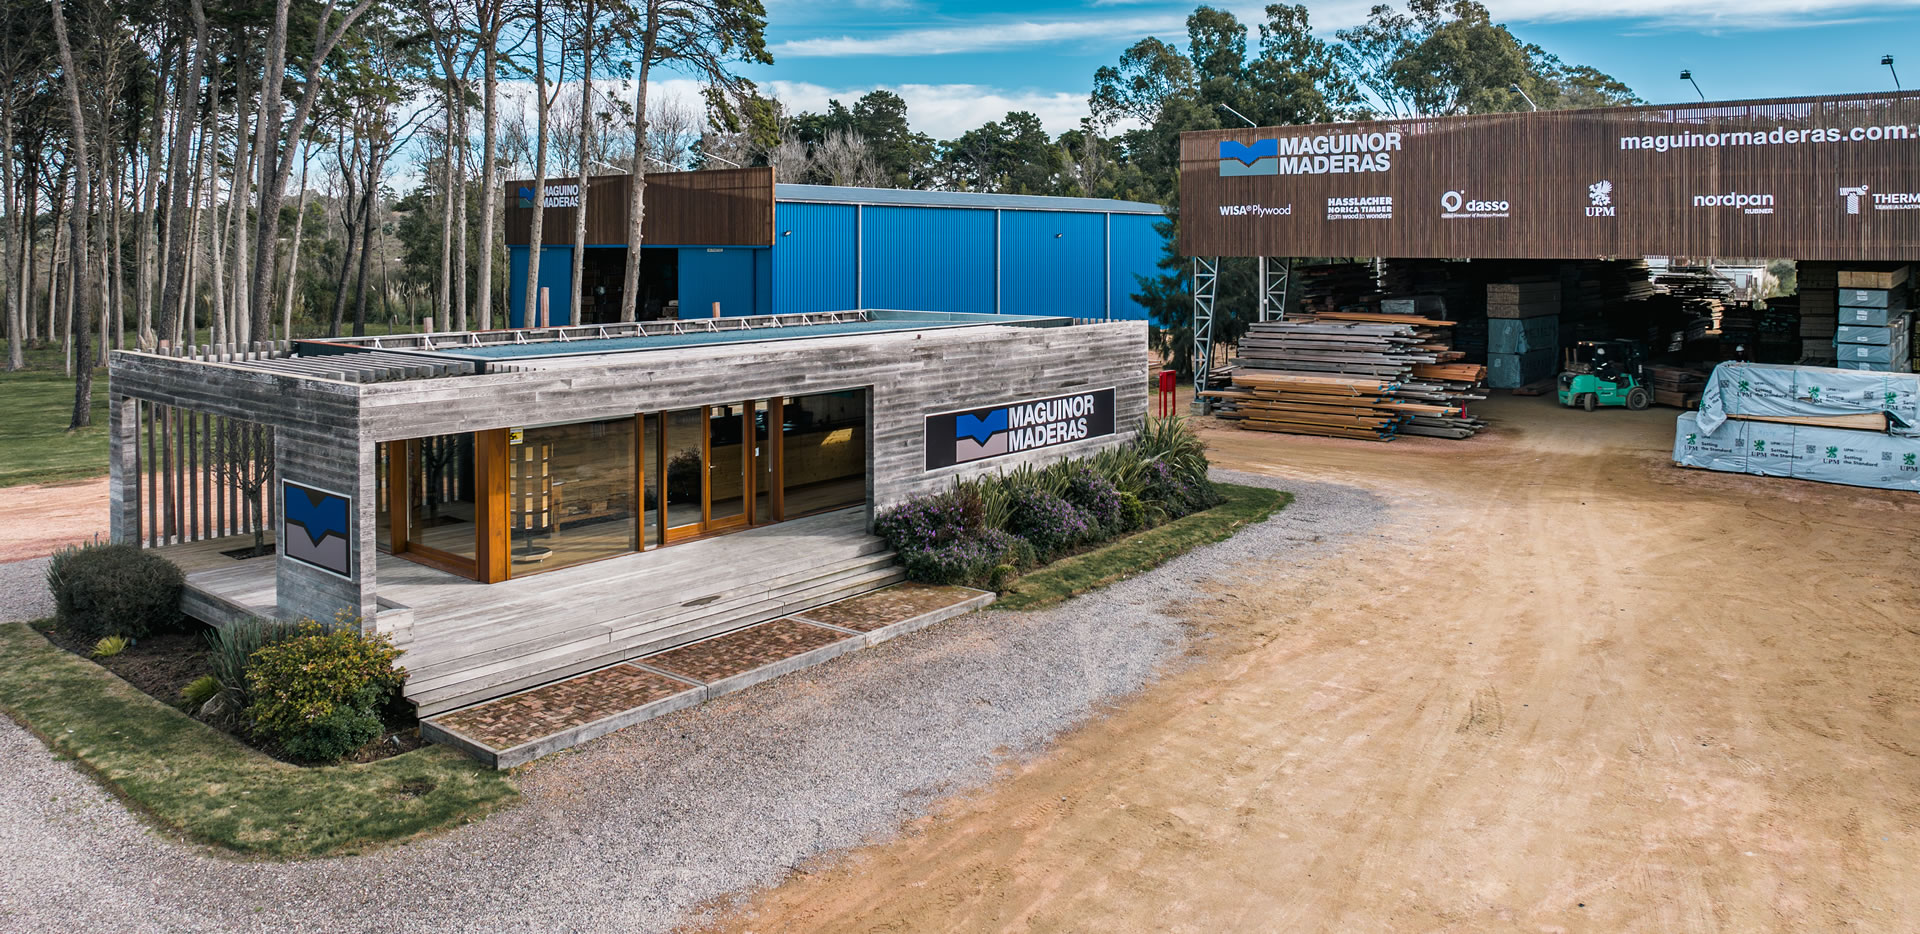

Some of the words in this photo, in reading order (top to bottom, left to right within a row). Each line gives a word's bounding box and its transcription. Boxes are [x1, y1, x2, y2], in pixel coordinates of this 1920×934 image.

[1279, 132, 1402, 156] MAGUINOR
[1620, 124, 1920, 153] maguinormaderas.com.
[1279, 153, 1391, 175] MADERAS
[544, 184, 579, 196] MAGUINO
[543, 196, 579, 208] MADERAS
[1327, 197, 1392, 206] HASSLACHER
[1694, 192, 1774, 209] nordpan
[1872, 193, 1920, 204] THERM
[1327, 206, 1359, 214] NORICA
[1360, 205, 1392, 213] TIMBER
[1466, 199, 1509, 211] dasso
[1585, 206, 1616, 217] UPM
[1008, 394, 1094, 430] MAGUINOR
[1008, 417, 1088, 452] MADERAS
